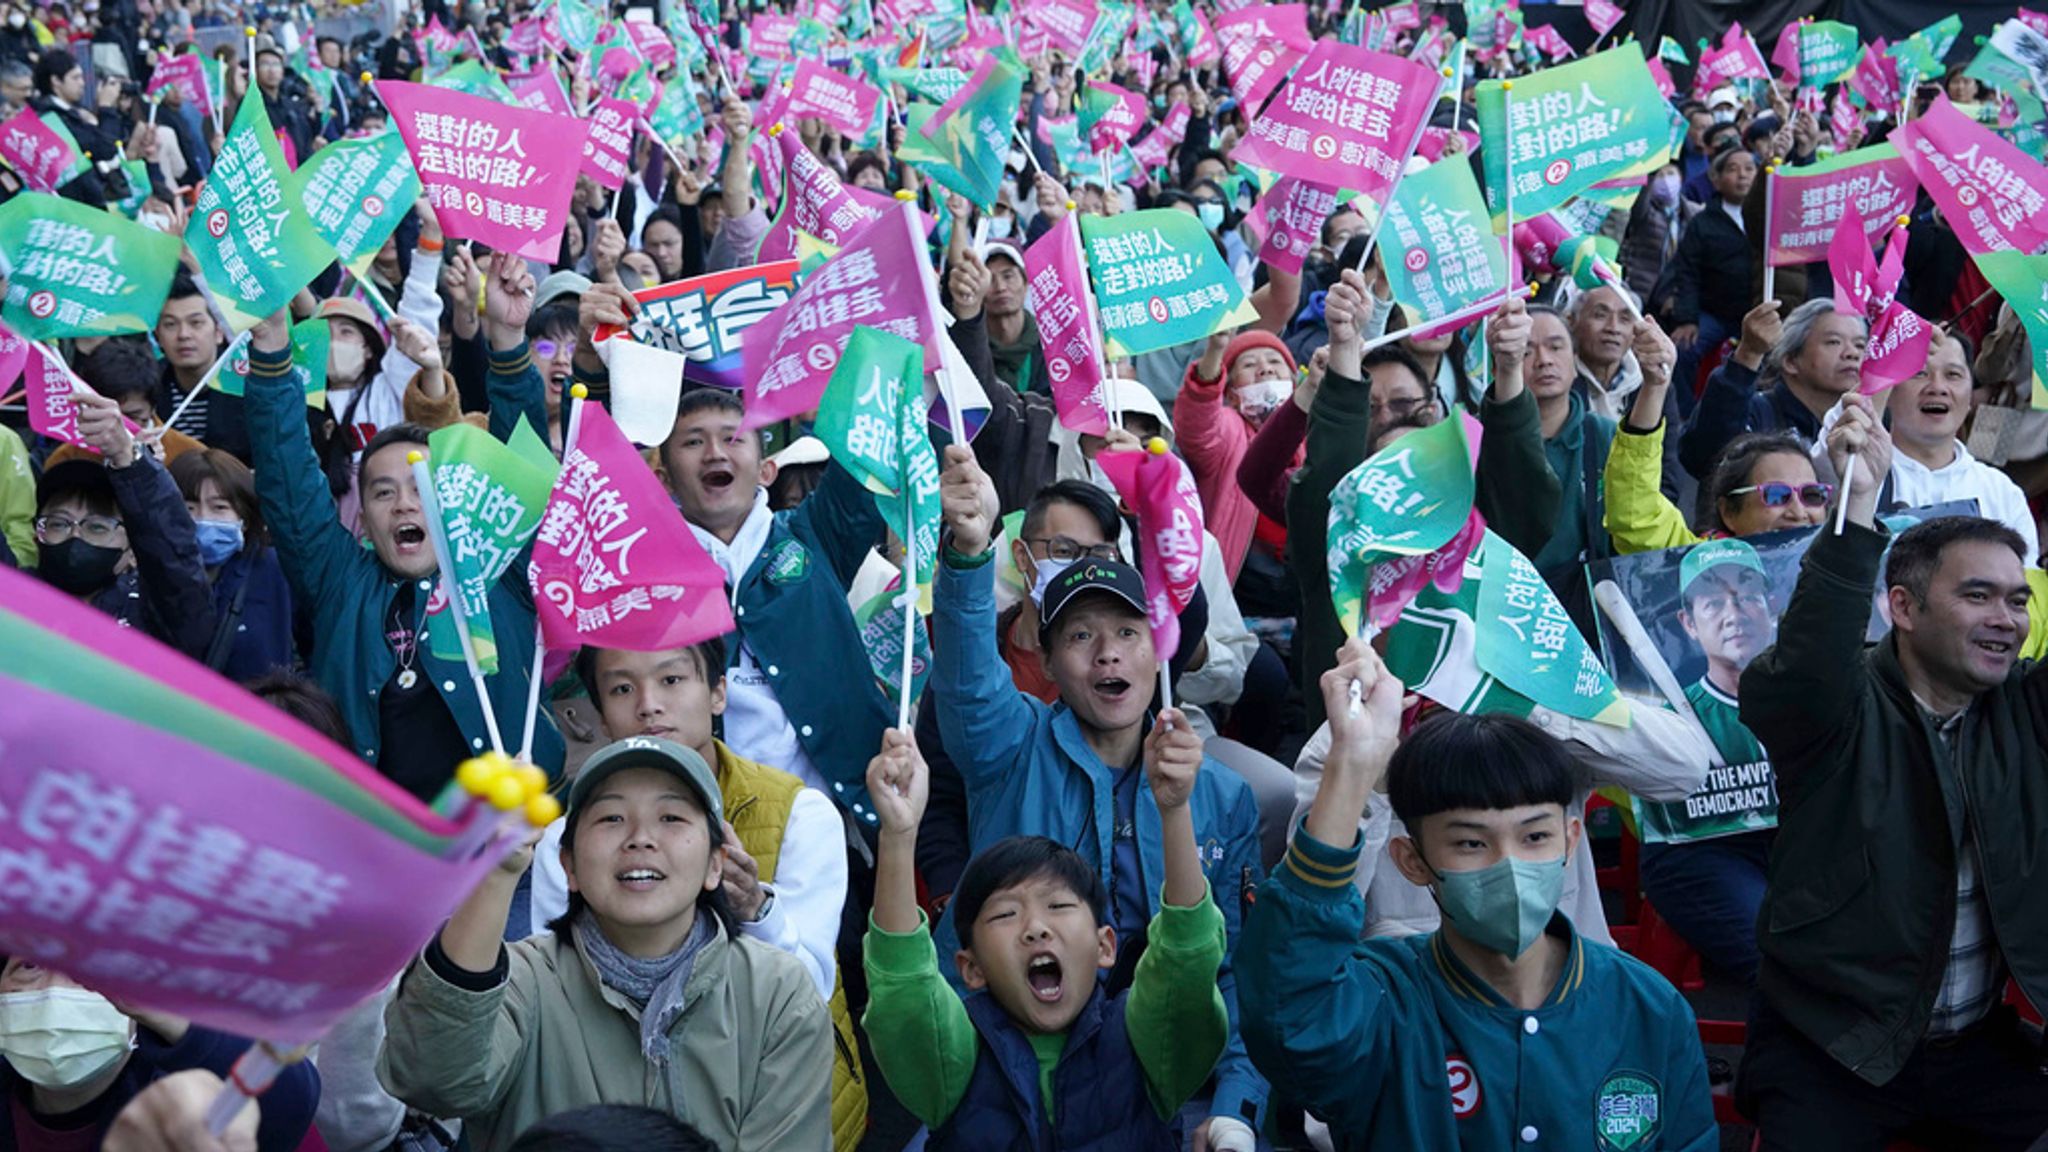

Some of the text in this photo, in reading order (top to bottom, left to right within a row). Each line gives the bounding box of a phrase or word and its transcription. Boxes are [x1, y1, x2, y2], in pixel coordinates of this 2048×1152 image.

[415, 110, 526, 159] 選對的人
[1511, 108, 1621, 165] 對的路!
[1573, 138, 1649, 171] 蕭美琴
[233, 126, 290, 237] 選對的人
[417, 144, 537, 188] 走對的路!
[214, 146, 278, 258] 走對的路!
[1801, 169, 1894, 209] 選對的人
[485, 198, 548, 232] 蕭美琴
[216, 233, 266, 301] 蕭美琴
[1092, 228, 1175, 266] 選對的人
[1102, 253, 1193, 296] 走對的路!
[1167, 283, 1230, 319] 蕭美琴
[1708, 761, 1770, 791] THE MVP
[1685, 785, 1770, 819] DEMOCRACY
[1606, 1118, 1641, 1134] 2024
